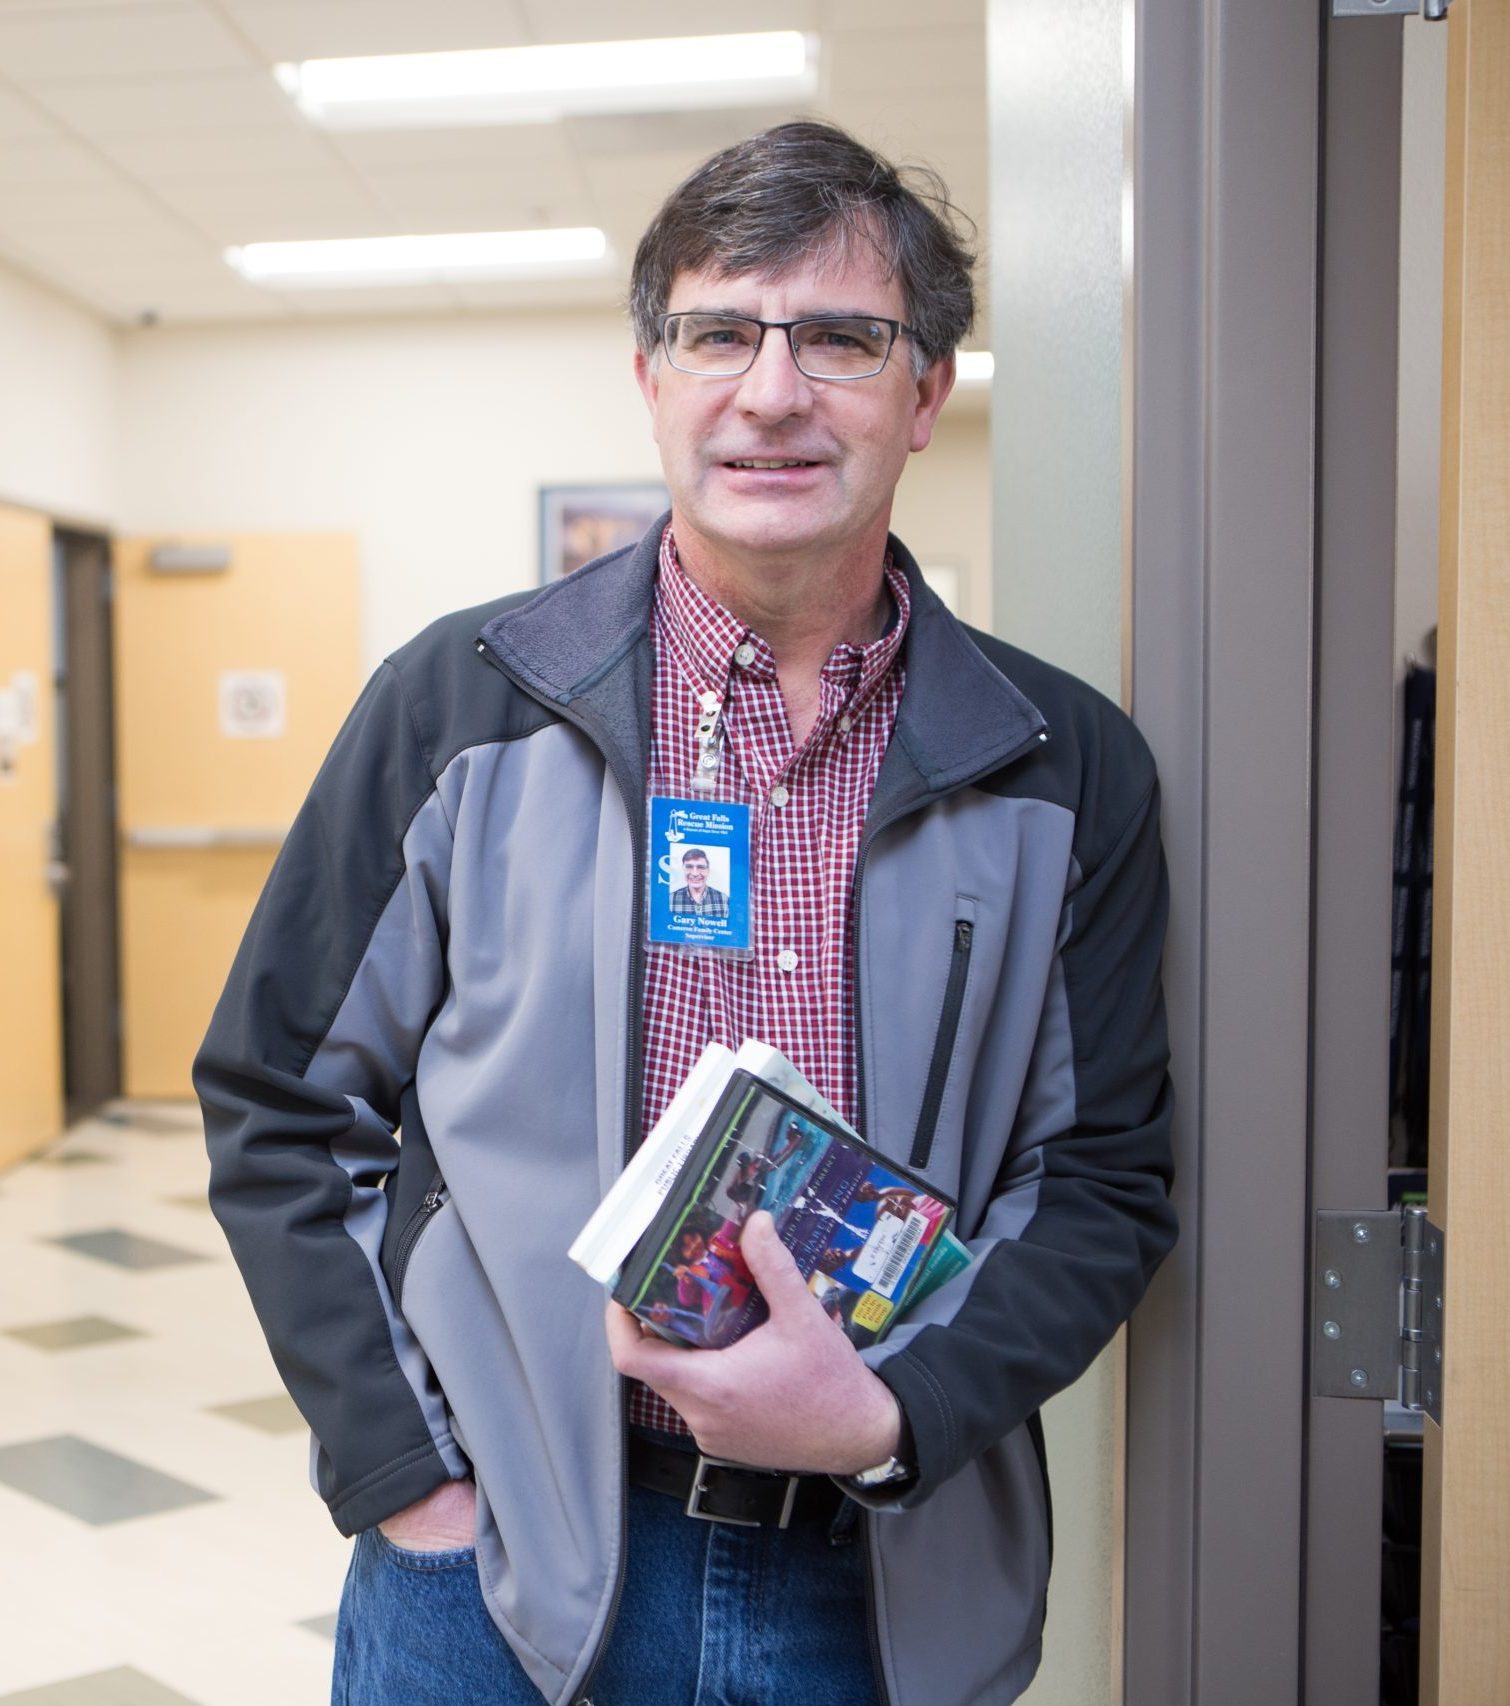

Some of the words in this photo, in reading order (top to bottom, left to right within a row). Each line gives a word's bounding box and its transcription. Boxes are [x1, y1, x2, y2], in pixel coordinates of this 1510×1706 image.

[689, 812, 711, 821] Great
[712, 813, 730, 822] Falls
[677, 818, 704, 828] Rescue
[705, 820, 734, 831] Mission
[673, 915, 696, 927] Gary
[697, 916, 728, 928] Nowell
[803, 1178, 849, 1254] PARENING
